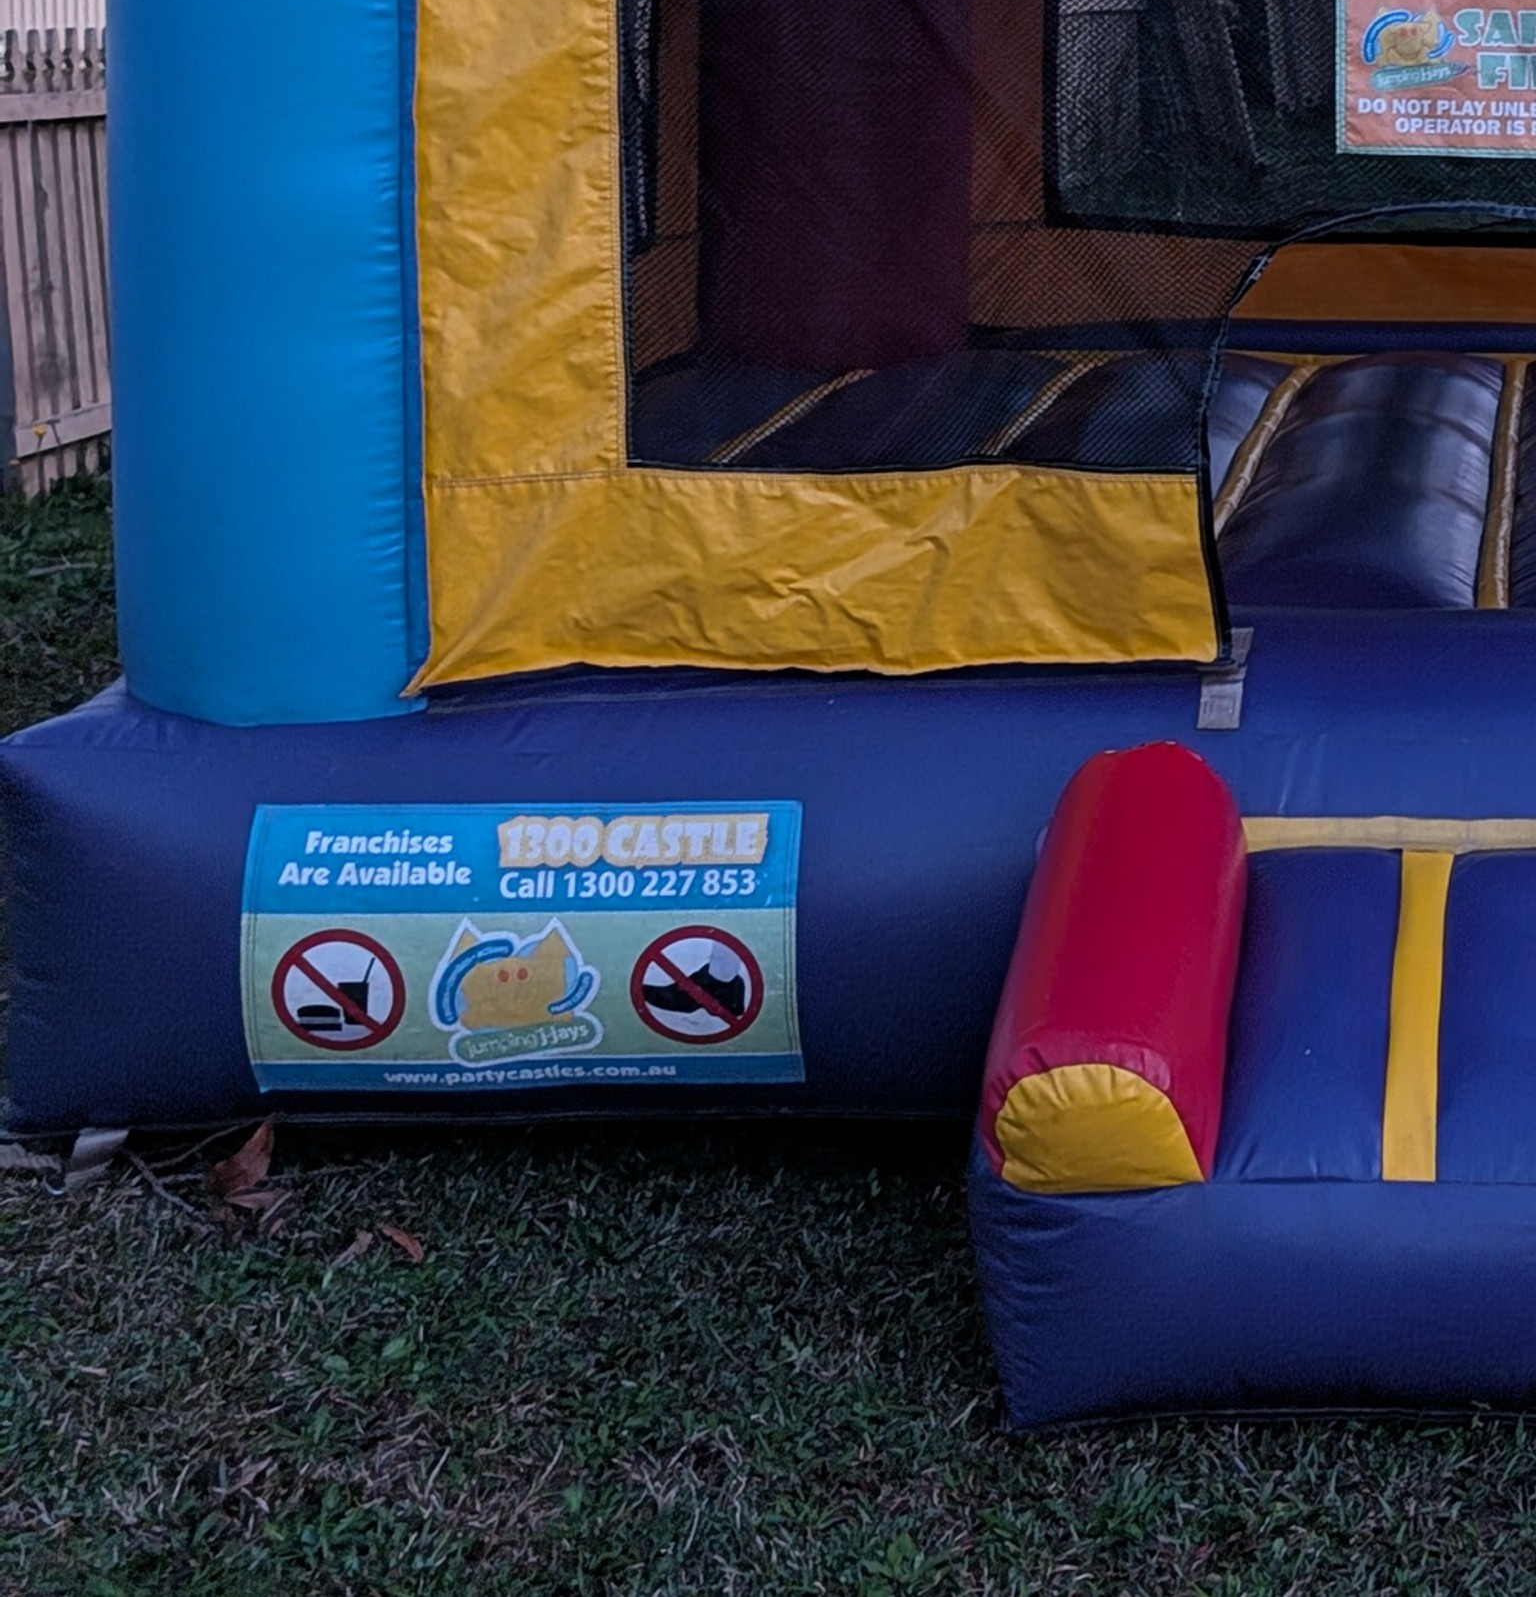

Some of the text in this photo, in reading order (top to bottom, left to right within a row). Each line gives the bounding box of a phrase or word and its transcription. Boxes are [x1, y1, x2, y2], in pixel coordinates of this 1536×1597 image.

[1357, 98, 1387, 114] DO
[1391, 99, 1431, 115] NOT
[1436, 100, 1486, 117] PLAY
[1395, 118, 1500, 135] OPERATOR
[1506, 119, 1526, 136] IS
[305, 830, 454, 855] Franchises
[503, 820, 762, 861] 1300 CASTLE
[278, 860, 473, 886] Are Available
[500, 868, 757, 899] Call 1300 227 853
[384, 1064, 678, 1086] www.partycastles.com.au
